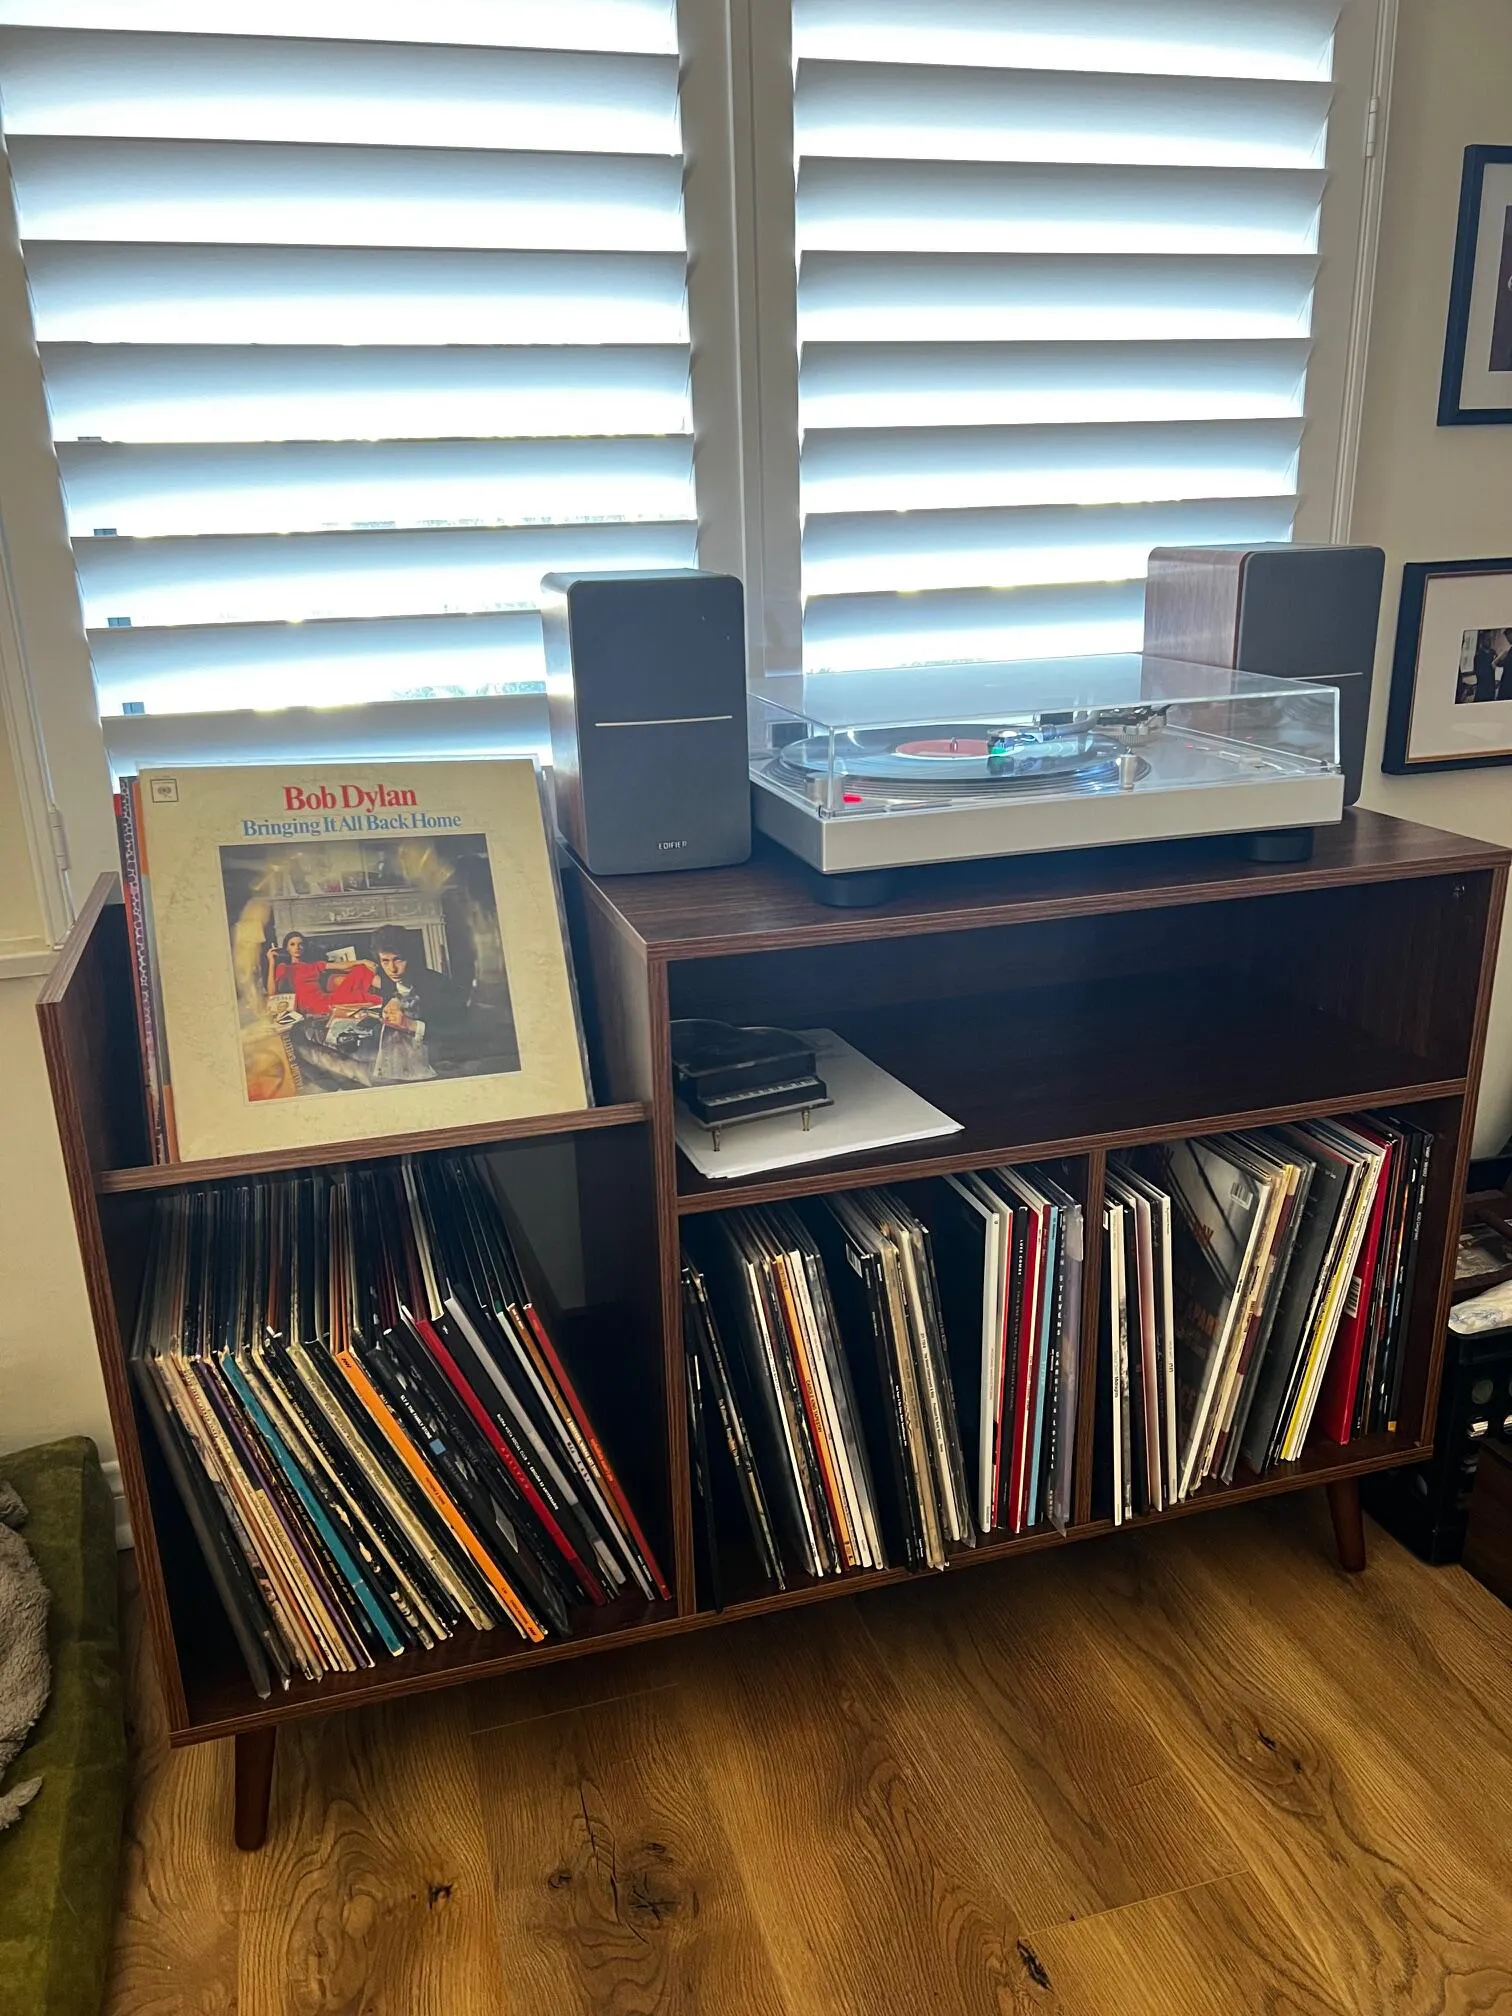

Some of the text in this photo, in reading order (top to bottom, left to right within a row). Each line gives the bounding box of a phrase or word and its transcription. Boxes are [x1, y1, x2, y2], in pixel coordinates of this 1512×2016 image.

[283, 784, 418, 813] Bob Dylan
[243, 813, 462, 837] Bringing It All Back Home
[658, 841, 687, 849] EDIFIER
[399, 1394, 407, 1403] SLY
[406, 1404, 415, 1414] THE
[411, 1412, 424, 1427] FAMILY
[420, 1425, 433, 1439] STONE
[805, 1379, 814, 1398] CAROLE
[812, 1410, 822, 1432] TAPESTRY
[495, 1413, 528, 1461] BUENA VISTA SOCIAL CLUB
